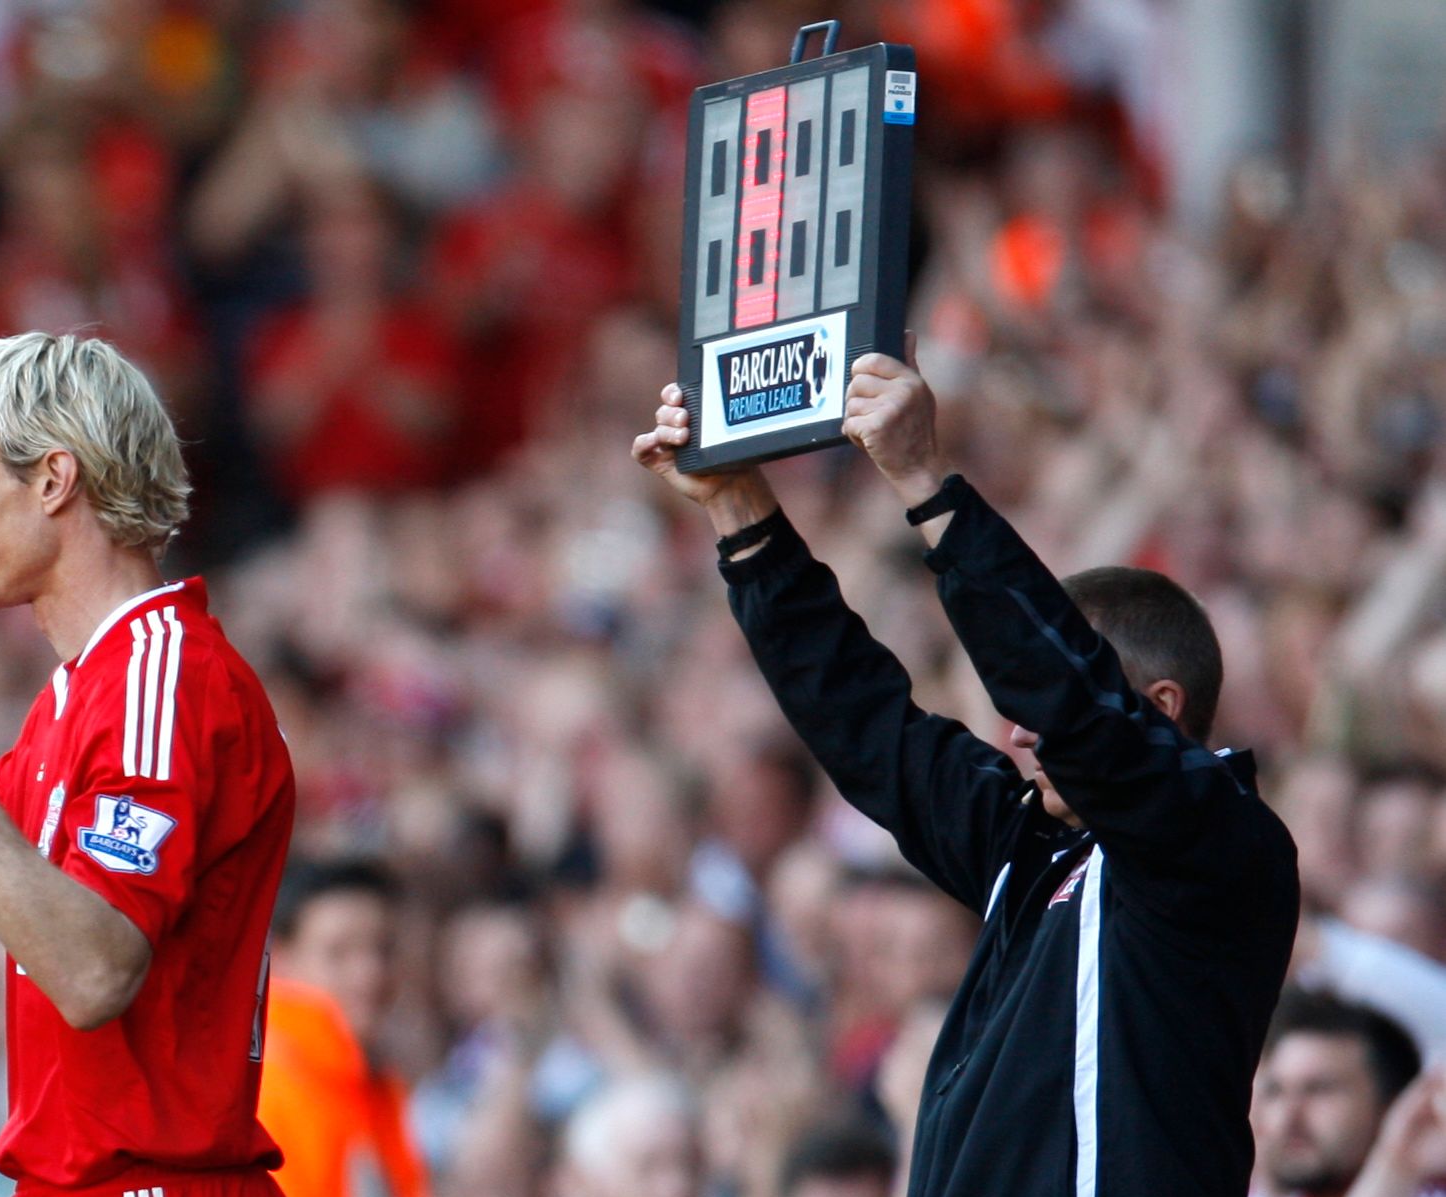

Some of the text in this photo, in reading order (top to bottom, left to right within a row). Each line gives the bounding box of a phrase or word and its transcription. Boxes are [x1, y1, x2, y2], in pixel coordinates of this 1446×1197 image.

[729, 340, 805, 395] BARCLAYS
[728, 383, 803, 421] PREMIER LEAGUE
